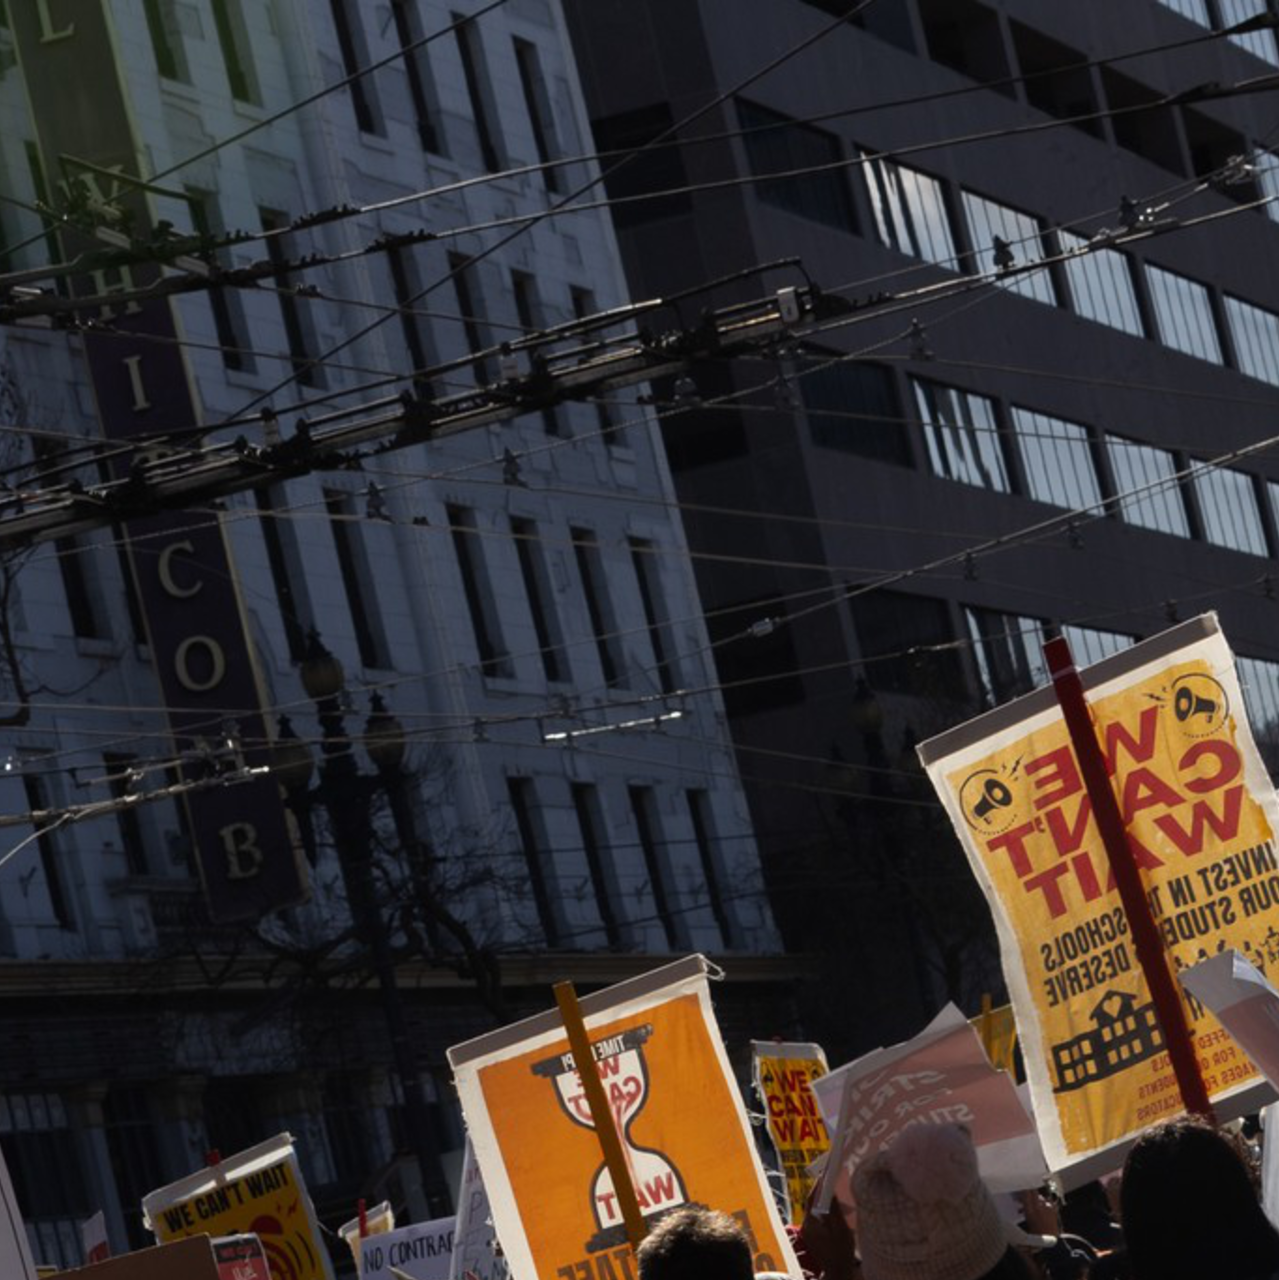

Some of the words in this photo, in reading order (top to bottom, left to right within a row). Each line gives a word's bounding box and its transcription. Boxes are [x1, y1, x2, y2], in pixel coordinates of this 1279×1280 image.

[777, 1070, 811, 1093] WE
[768, 1094, 817, 1118] CAN
[163, 1203, 195, 1233] WE
[195, 1184, 245, 1221] CAN'T
[245, 1164, 290, 1200] WAIT
[363, 1246, 384, 1274] NO
[389, 1230, 456, 1267] CONTRAC
